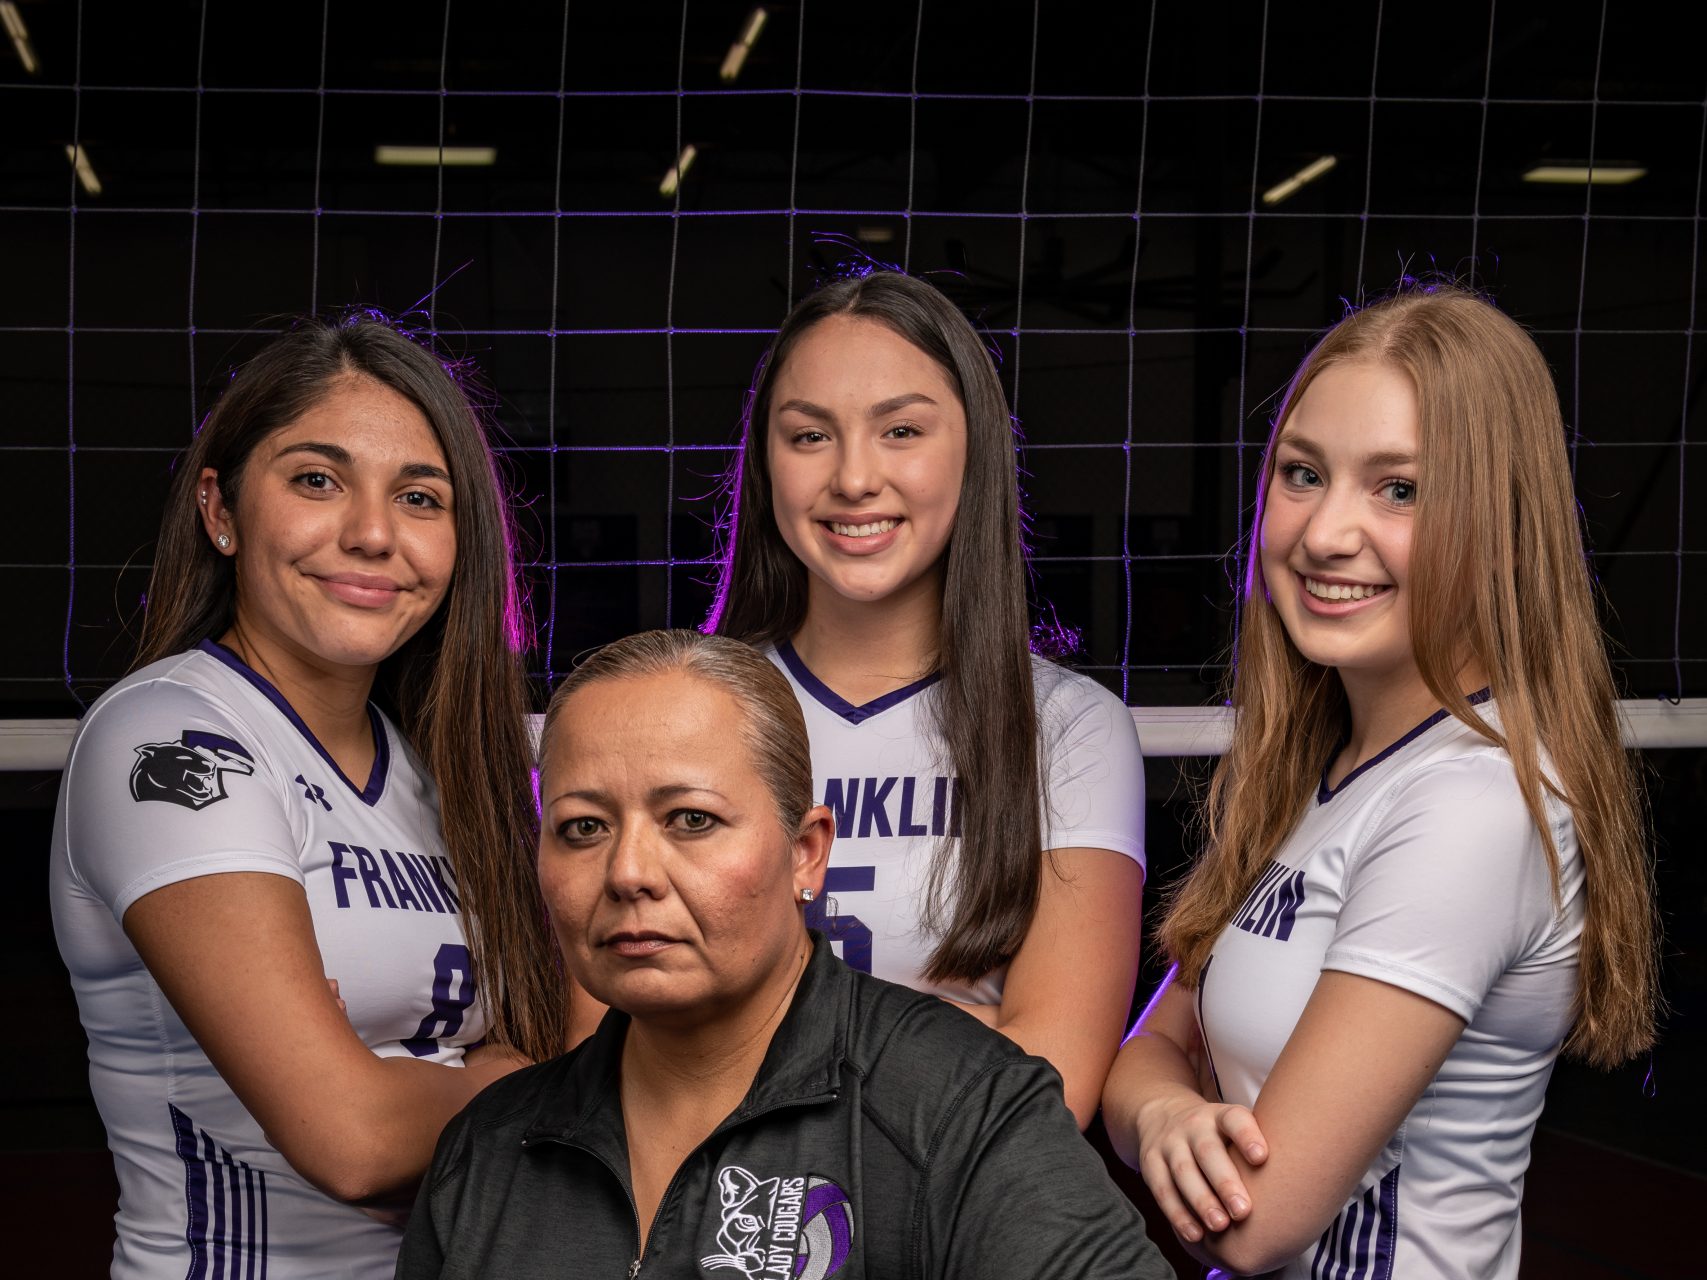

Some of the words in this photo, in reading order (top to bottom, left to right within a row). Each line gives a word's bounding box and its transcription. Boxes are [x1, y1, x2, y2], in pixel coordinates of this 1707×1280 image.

[327, 841, 463, 914] FRANK
[400, 943, 476, 1057] 8
[772, 1177, 805, 1241] COUGARS
